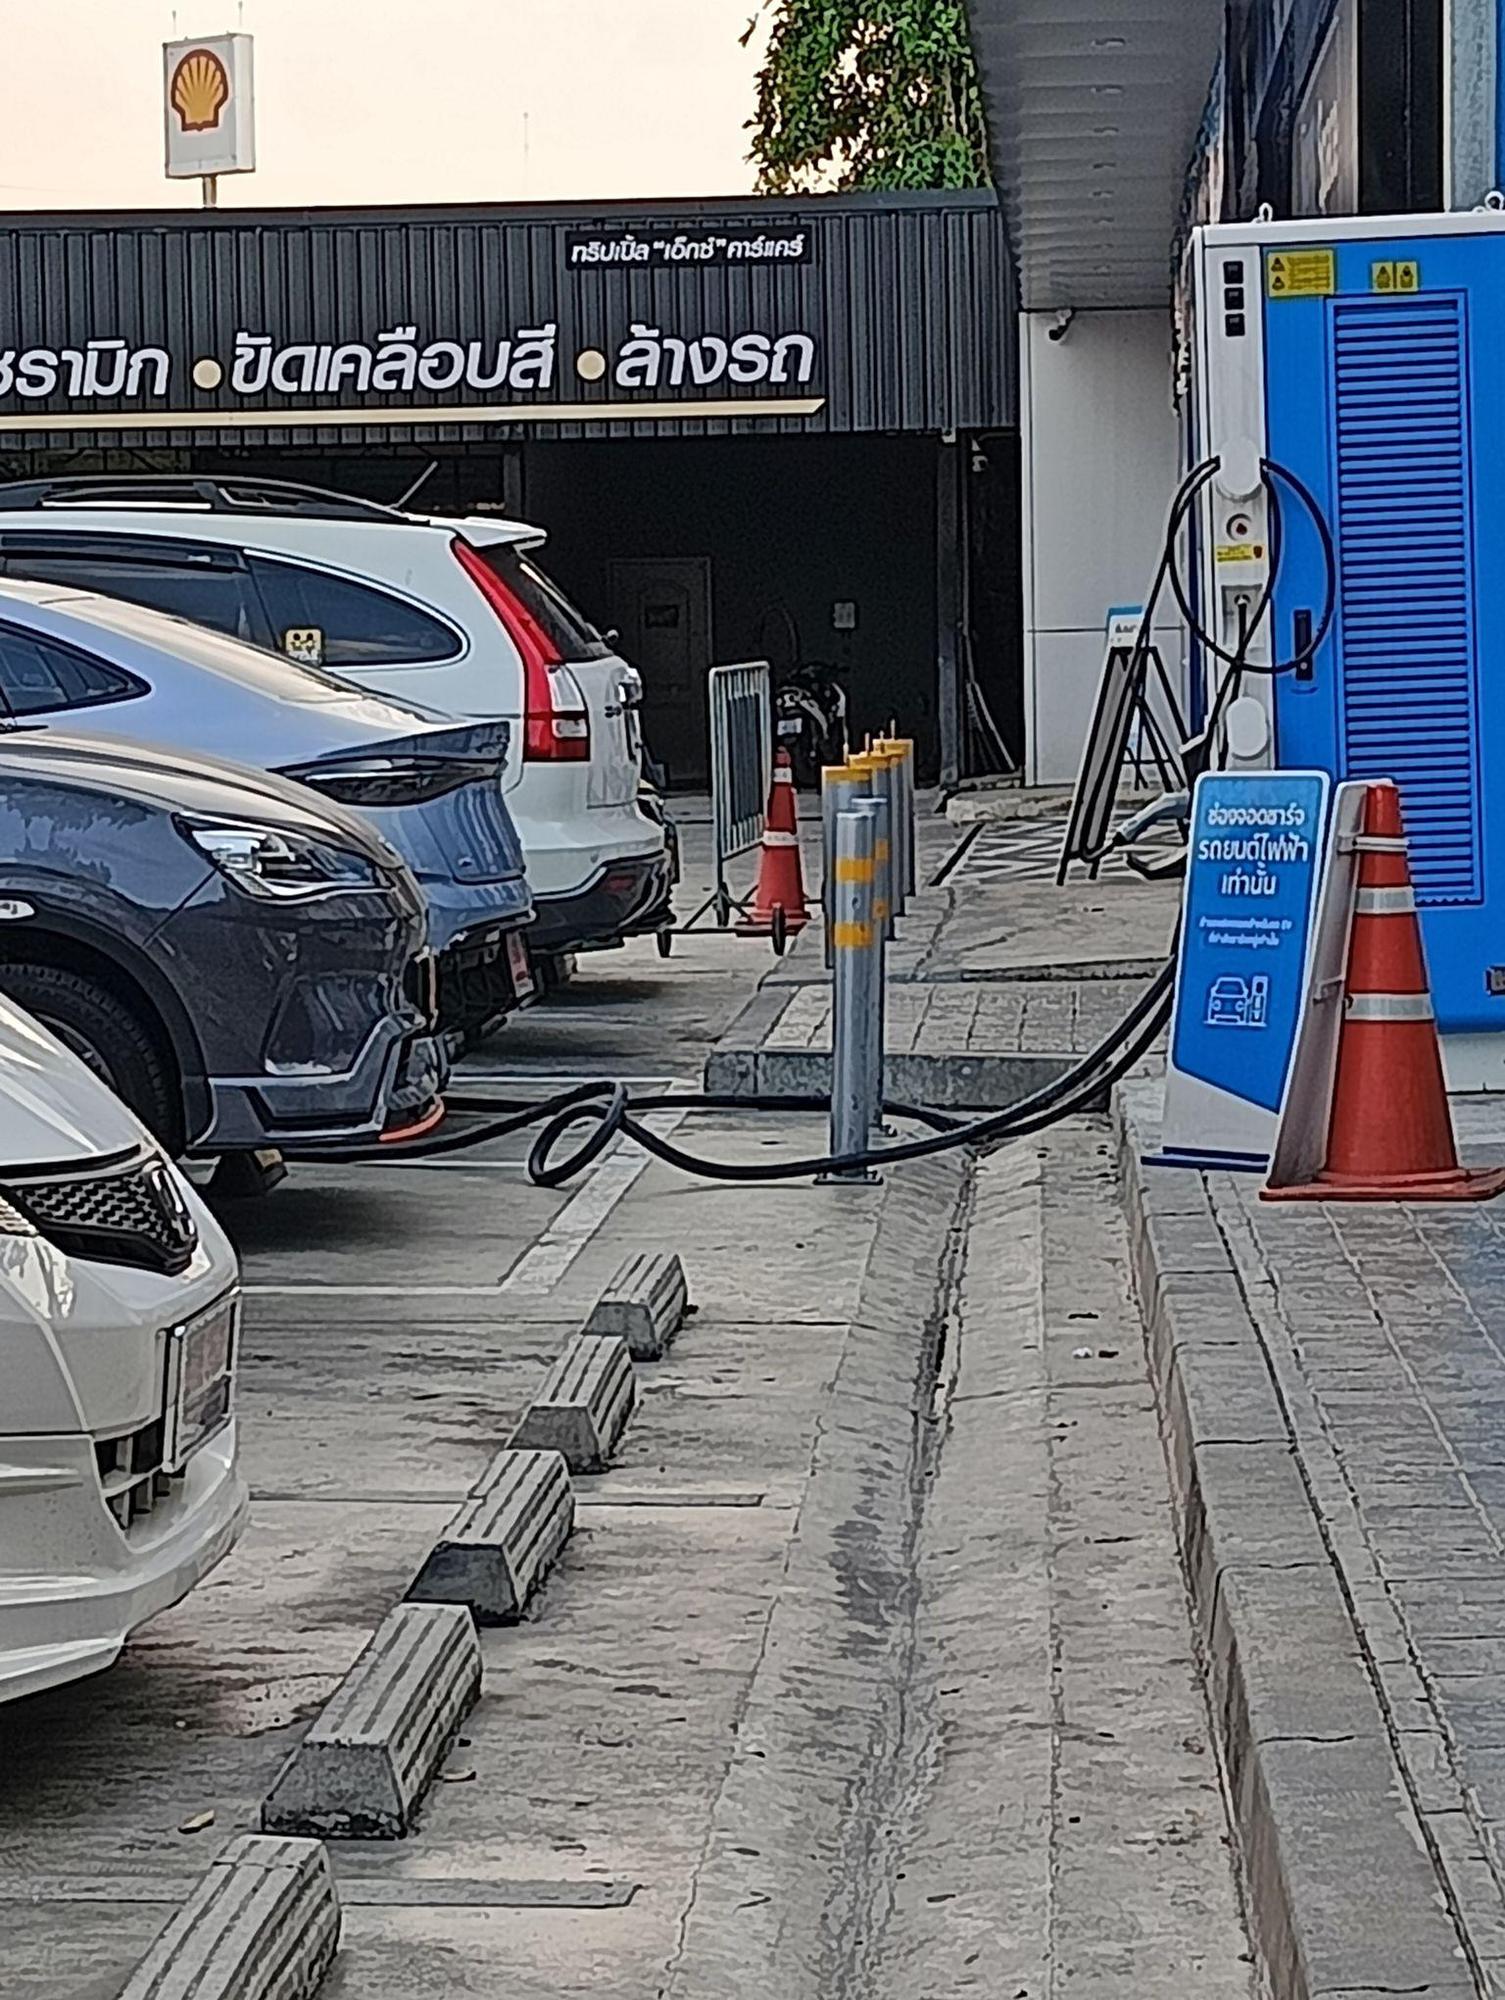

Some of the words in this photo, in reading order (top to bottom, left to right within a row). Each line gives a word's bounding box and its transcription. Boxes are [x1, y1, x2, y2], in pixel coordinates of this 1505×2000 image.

[231, 322, 557, 394] ขัดเคลือบสี
[615, 323, 815, 387] ล้างรถ
[1197, 831, 1310, 862] รถยนต์ไฟฟ้า
[1220, 861, 1278, 895] เท่านั้น
